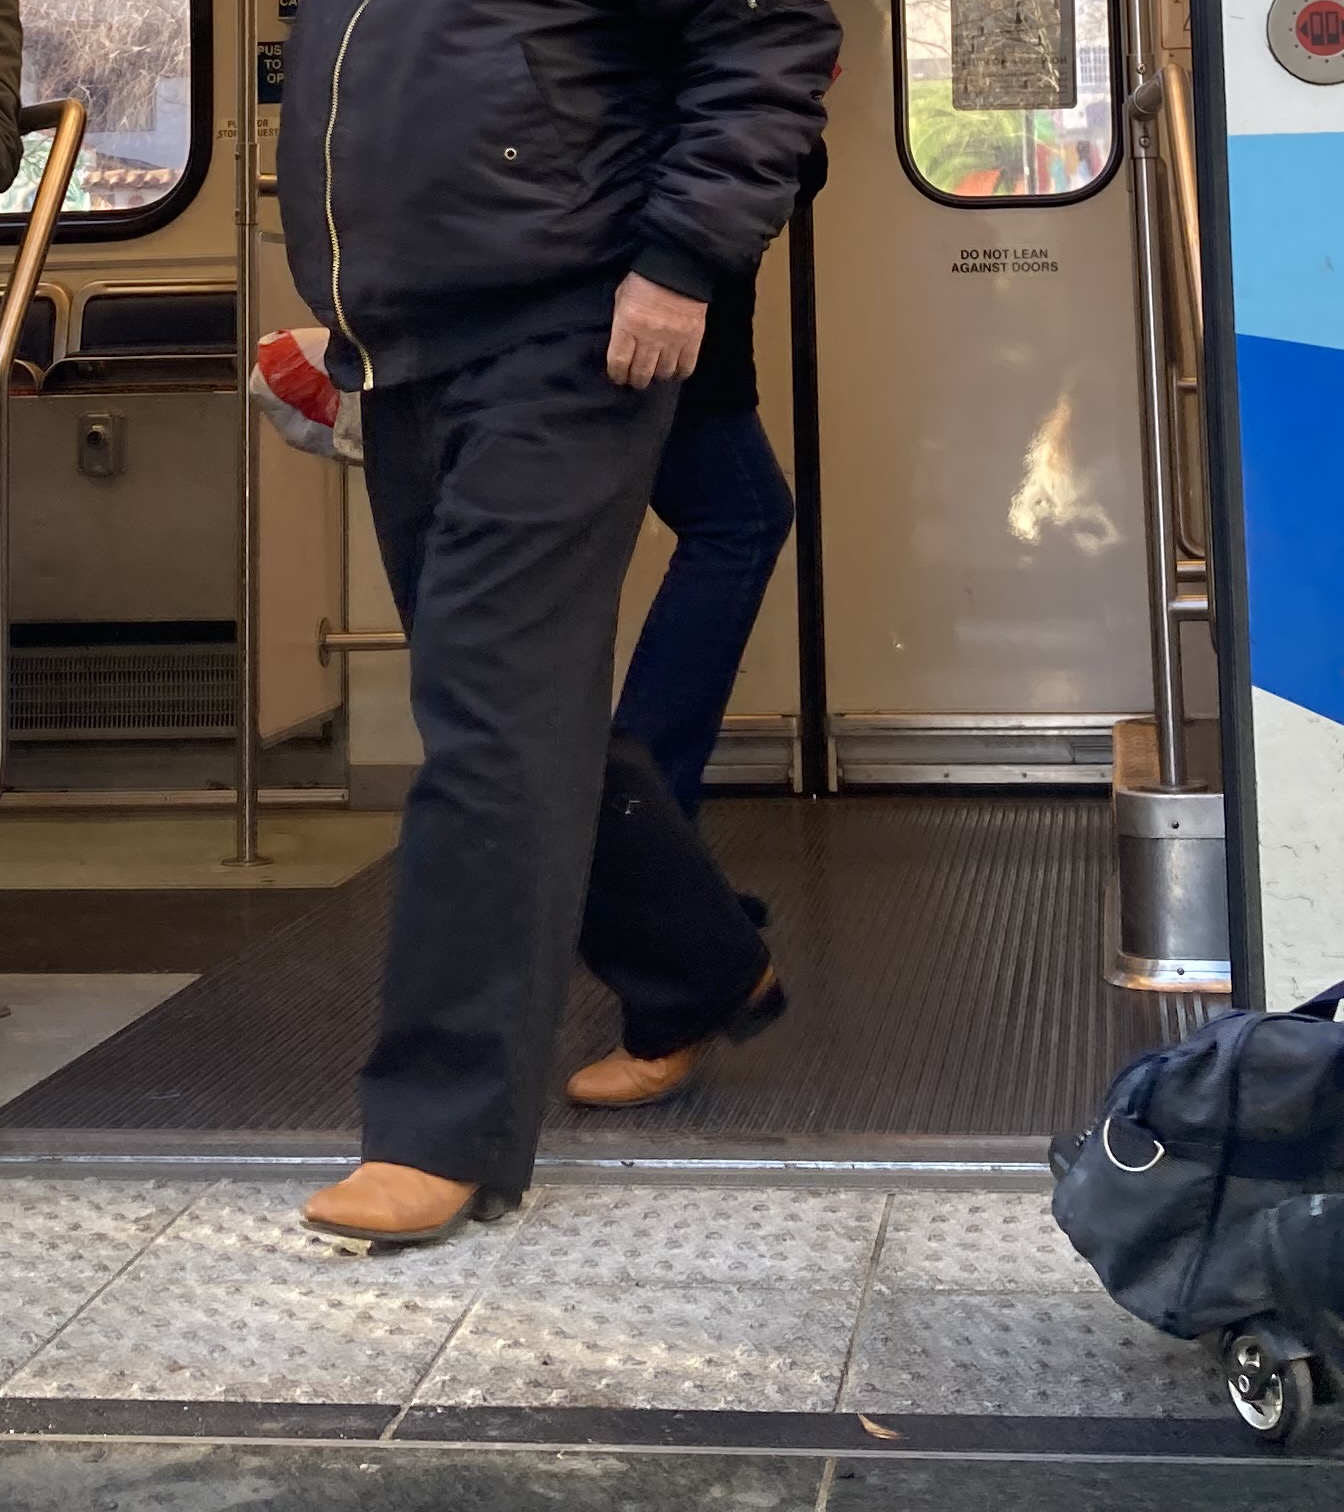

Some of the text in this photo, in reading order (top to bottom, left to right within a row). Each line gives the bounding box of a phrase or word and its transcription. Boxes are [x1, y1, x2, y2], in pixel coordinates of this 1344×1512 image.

[258, 44, 282, 56] PUS
[264, 59, 282, 69] TO
[960, 248, 1048, 260] DO NOT LEAN
[951, 261, 1059, 273] AGAINST DOORS
